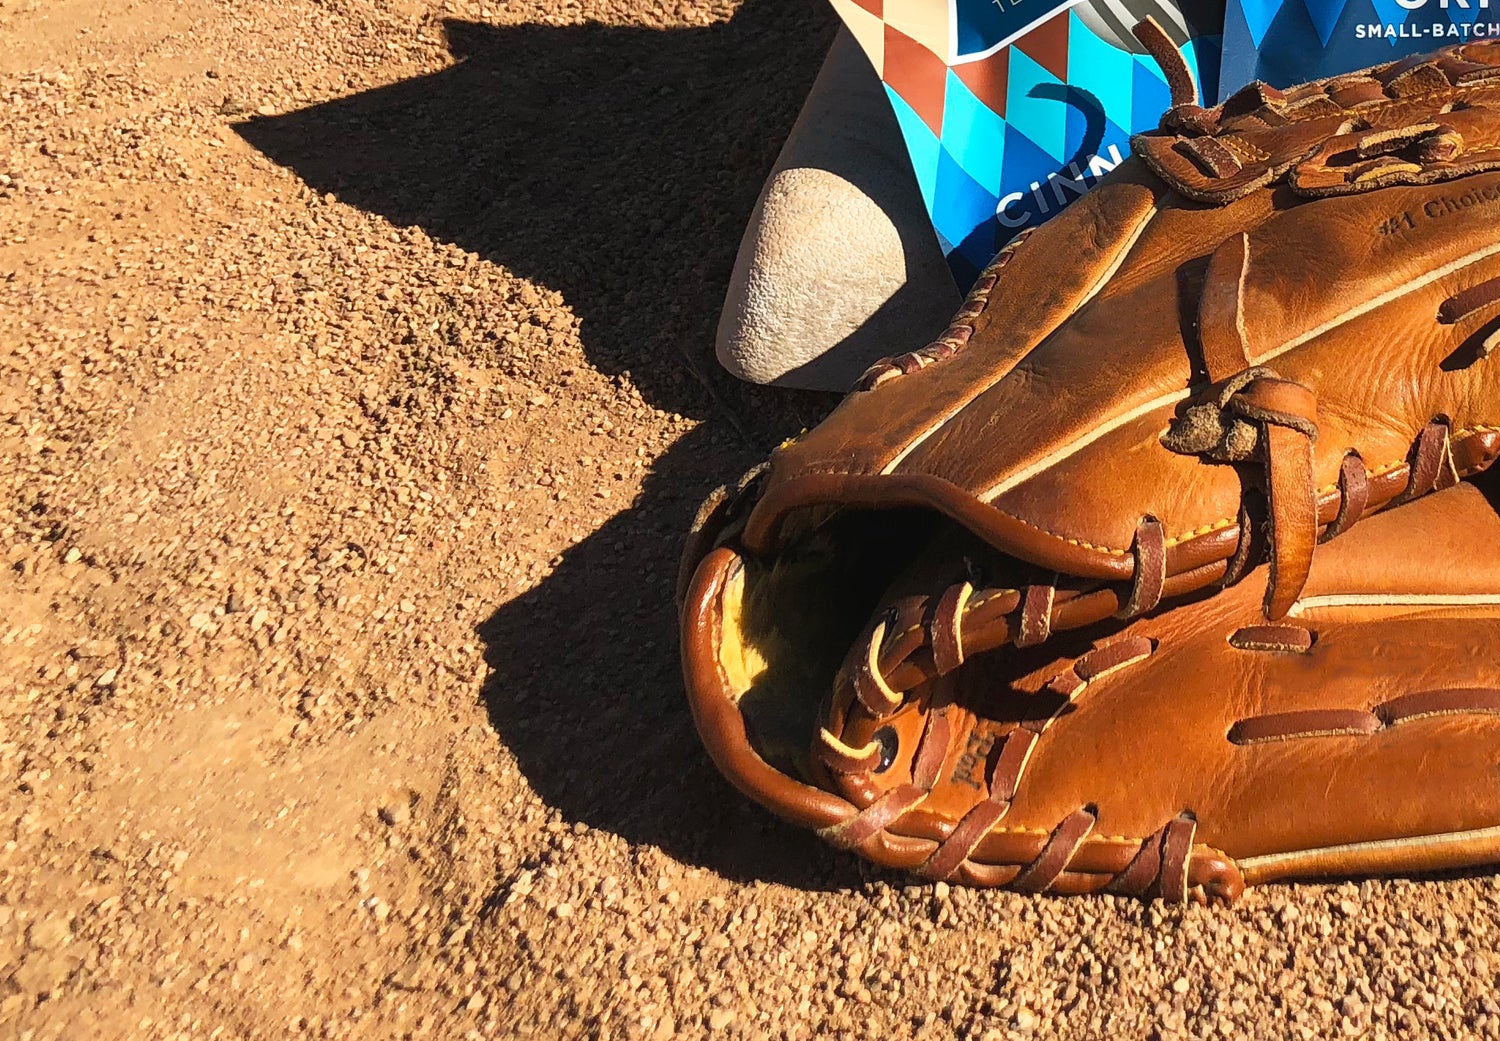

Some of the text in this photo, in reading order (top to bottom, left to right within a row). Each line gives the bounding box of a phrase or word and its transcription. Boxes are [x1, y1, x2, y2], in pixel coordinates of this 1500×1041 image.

[1355, 22, 1500, 38] SMALL-BATCH
[996, 144, 1123, 228] CINN
[1378, 211, 1416, 236] #1
